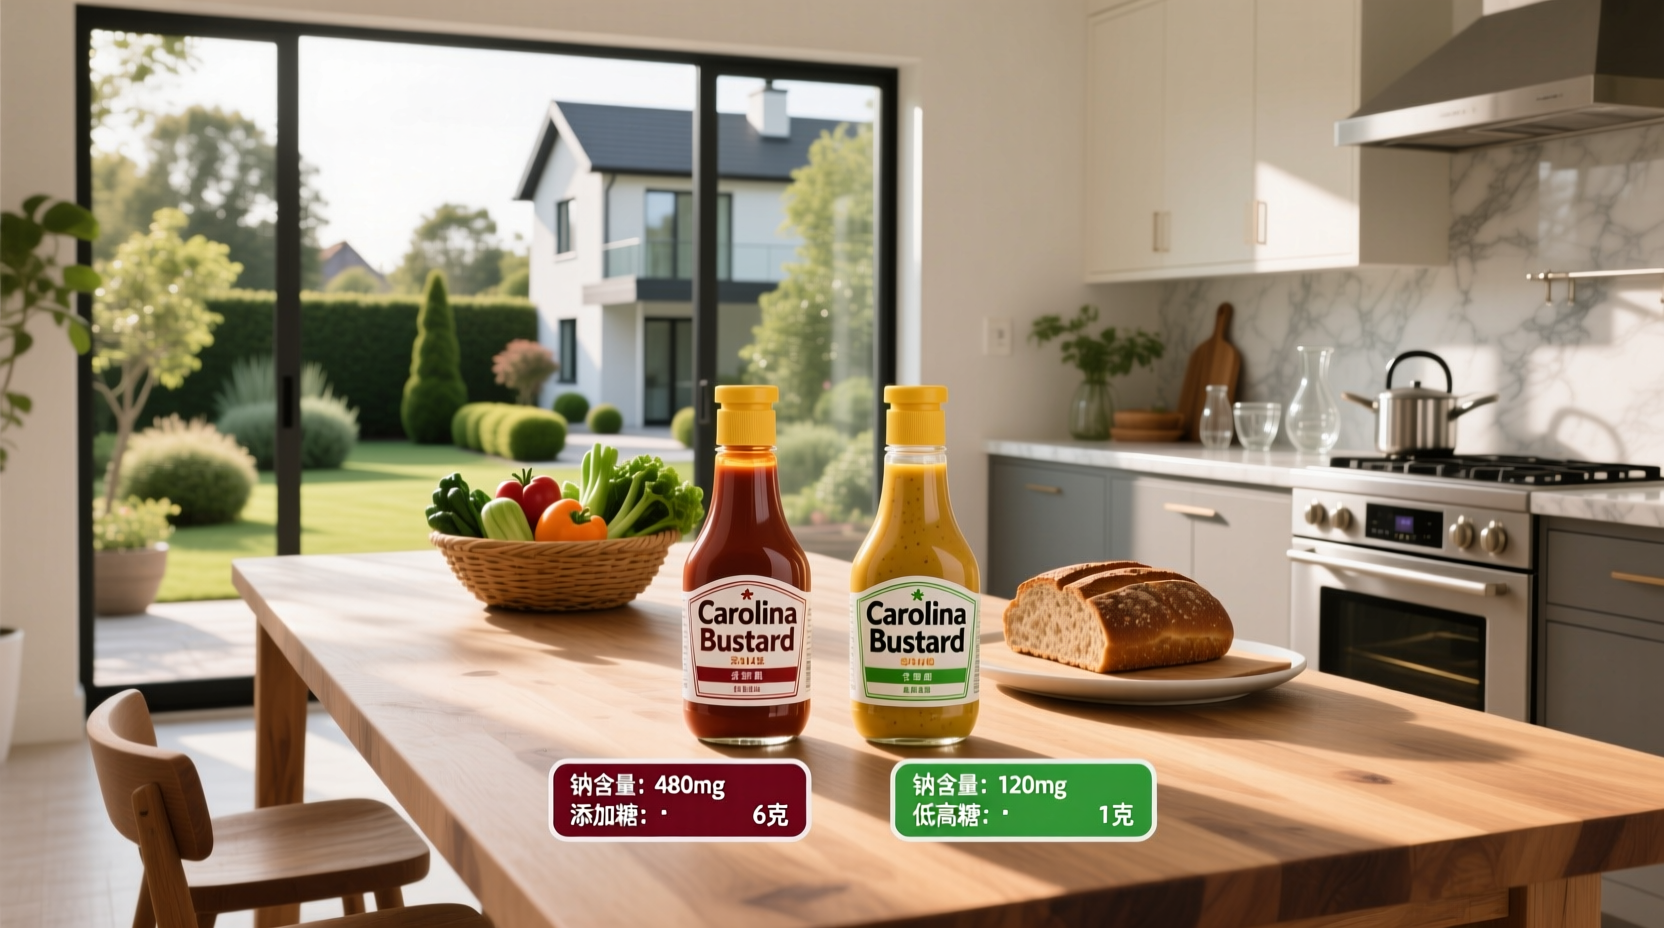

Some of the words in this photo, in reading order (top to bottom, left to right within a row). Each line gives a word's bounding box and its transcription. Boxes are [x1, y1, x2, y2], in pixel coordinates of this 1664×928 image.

[698, 599, 798, 625] Carolina
[866, 600, 967, 626] Carolina
[700, 626, 795, 653] Bustard
[869, 627, 965, 654] Bustard
